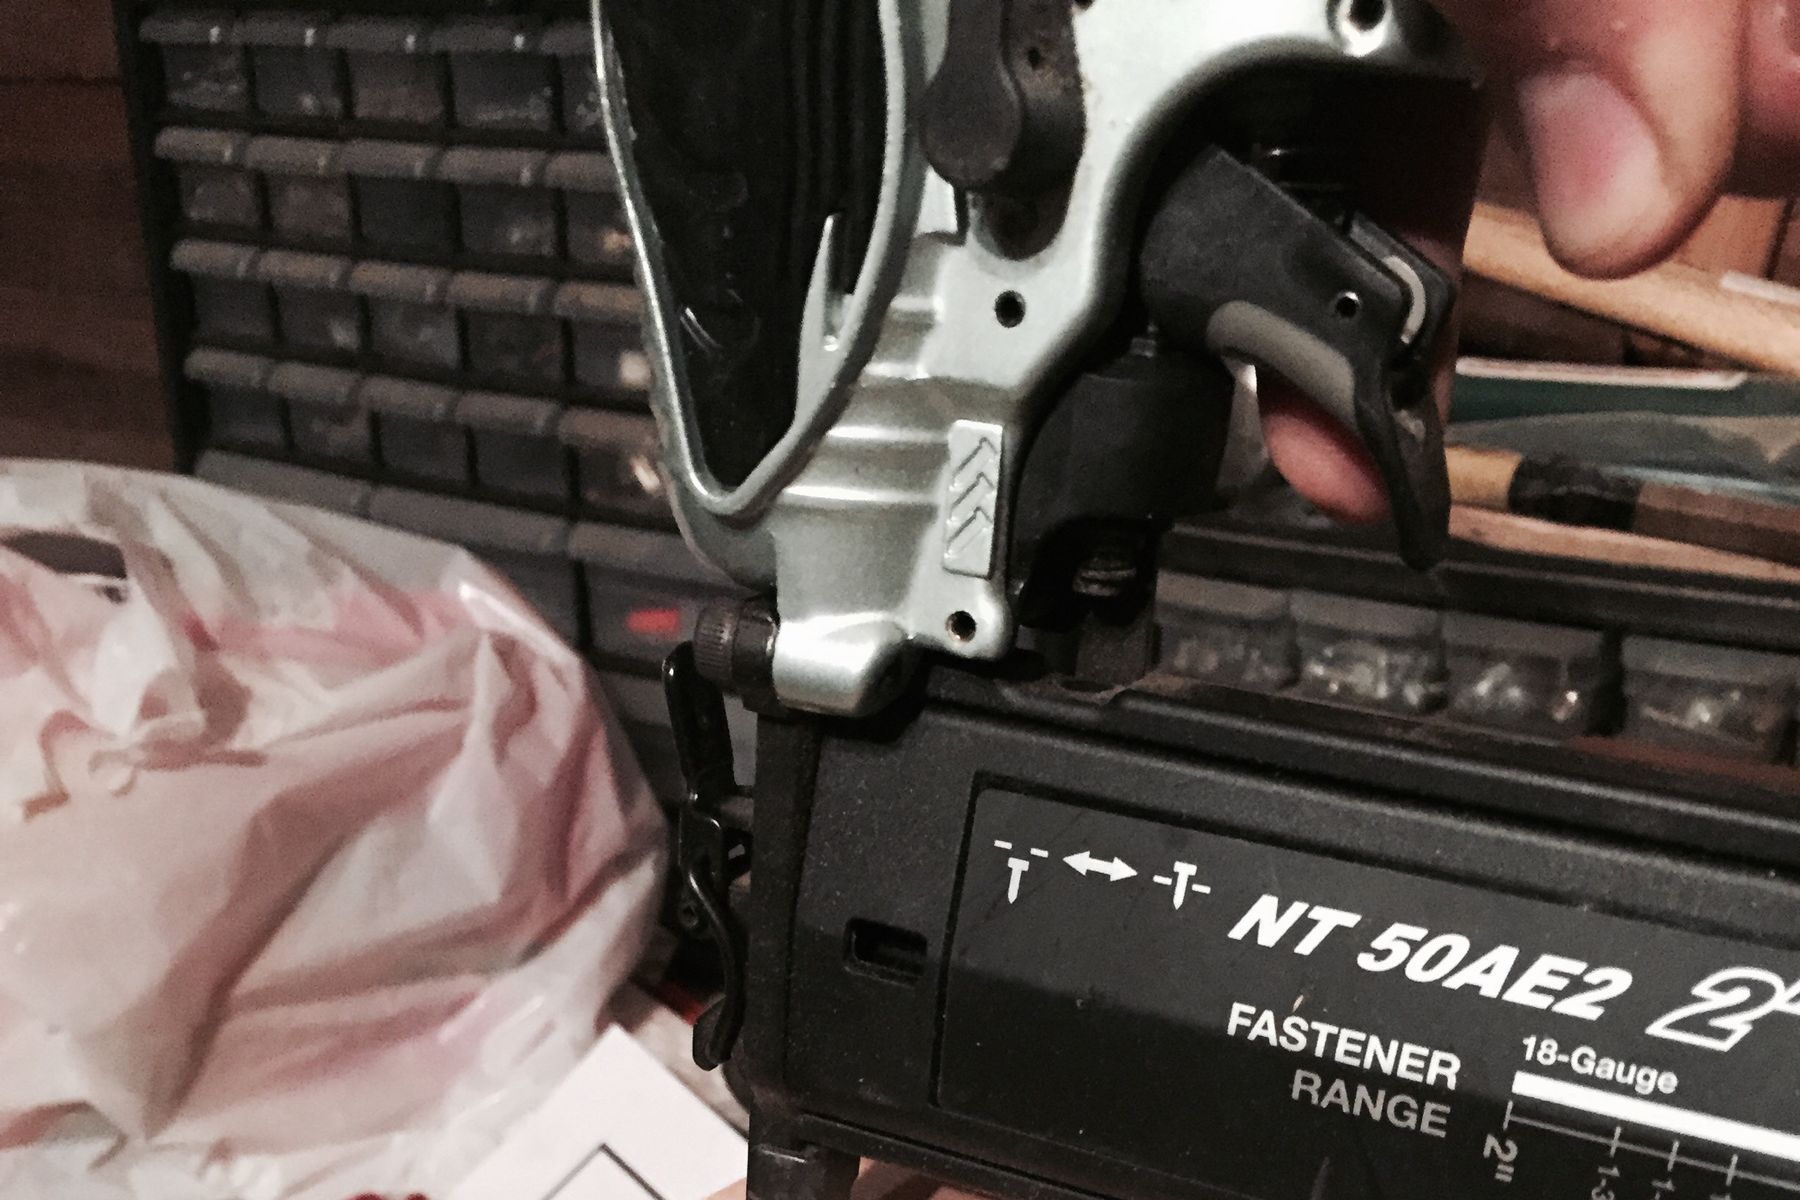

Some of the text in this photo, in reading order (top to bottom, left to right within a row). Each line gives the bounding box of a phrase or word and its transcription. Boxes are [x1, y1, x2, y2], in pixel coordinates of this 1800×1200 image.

[1227, 893, 1362, 956] NT
[1356, 922, 1633, 1022] 50AE2
[1227, 1001, 1461, 1090] FASTENER
[1522, 1034, 1679, 1095] 18-Gauge
[1291, 1068, 1451, 1138] RANGE
